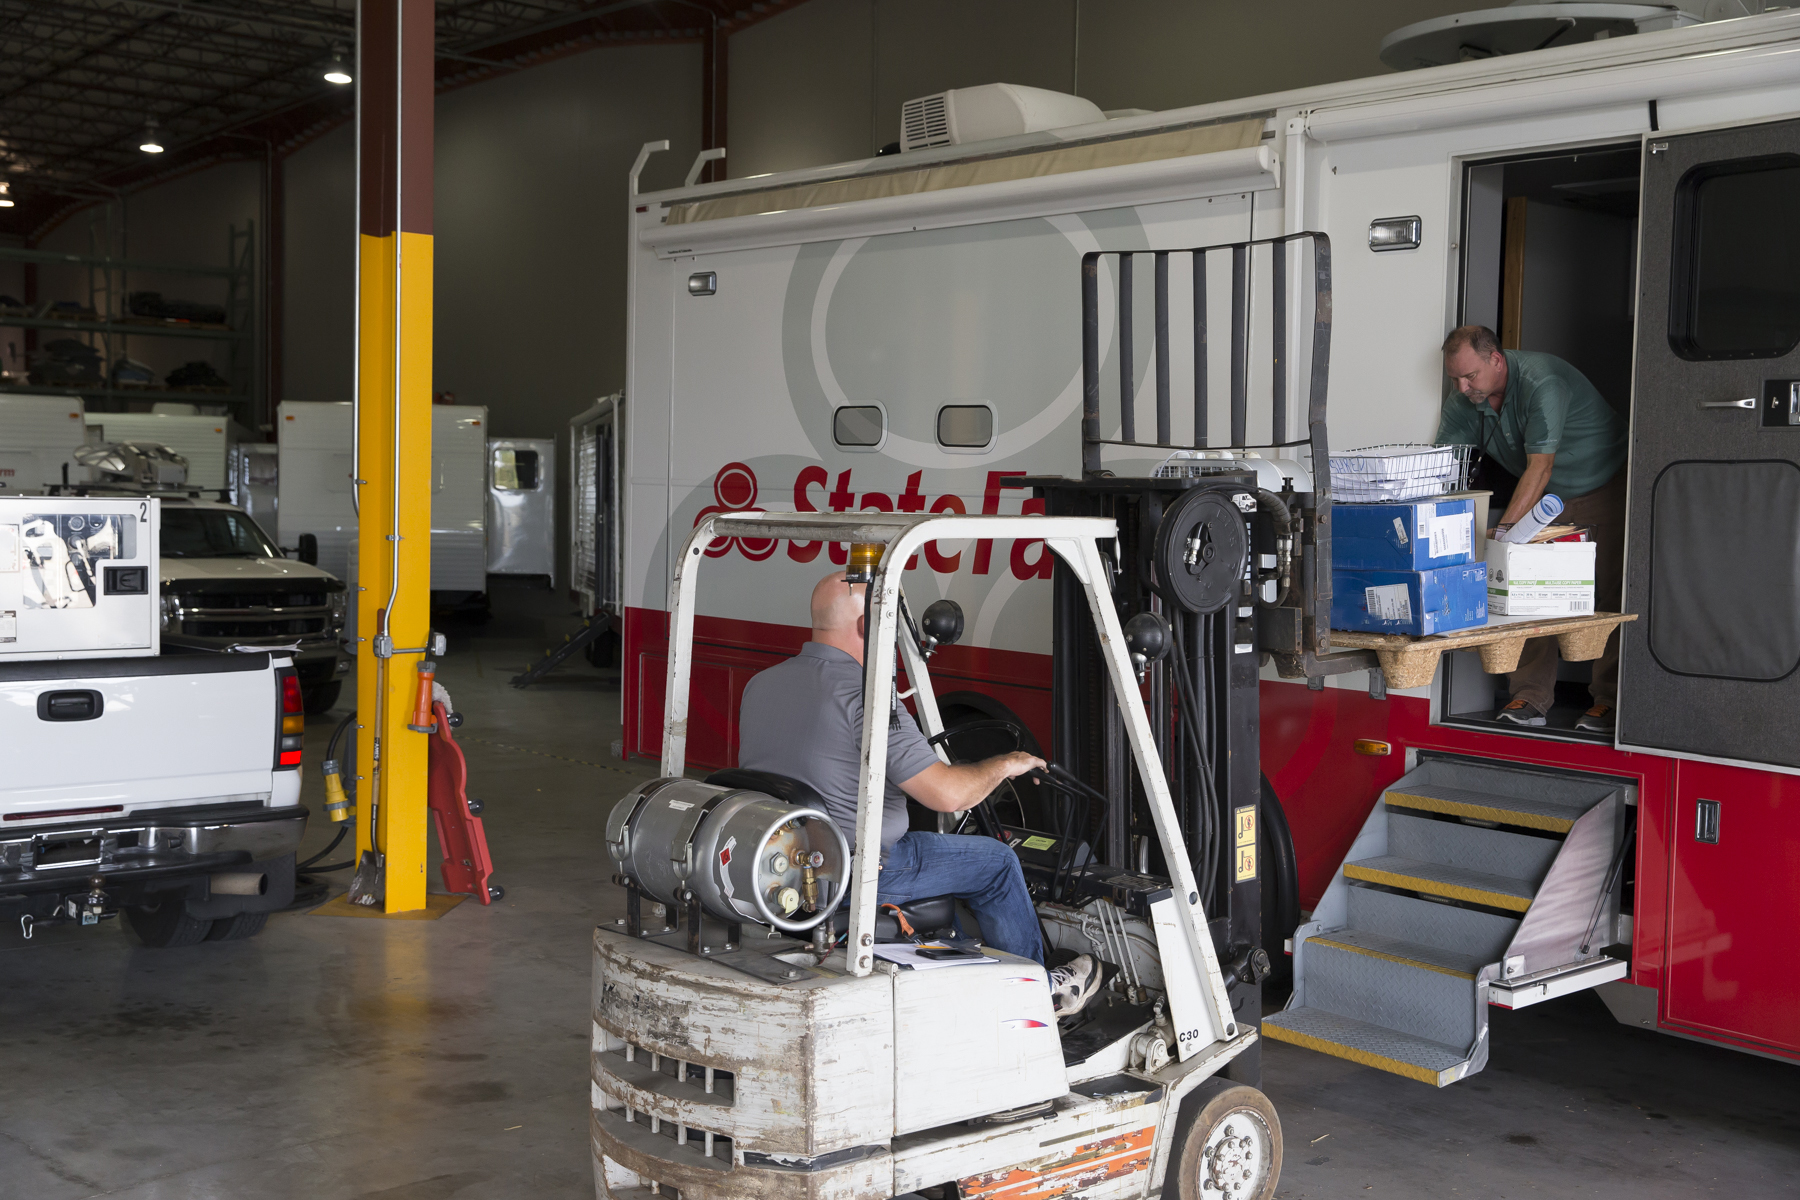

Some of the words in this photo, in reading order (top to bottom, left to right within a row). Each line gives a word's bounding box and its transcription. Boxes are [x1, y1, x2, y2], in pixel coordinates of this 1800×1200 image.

[140, 501, 147, 522] 2
[787, 465, 966, 573] Stte
[1179, 1029, 1198, 1042] C30
